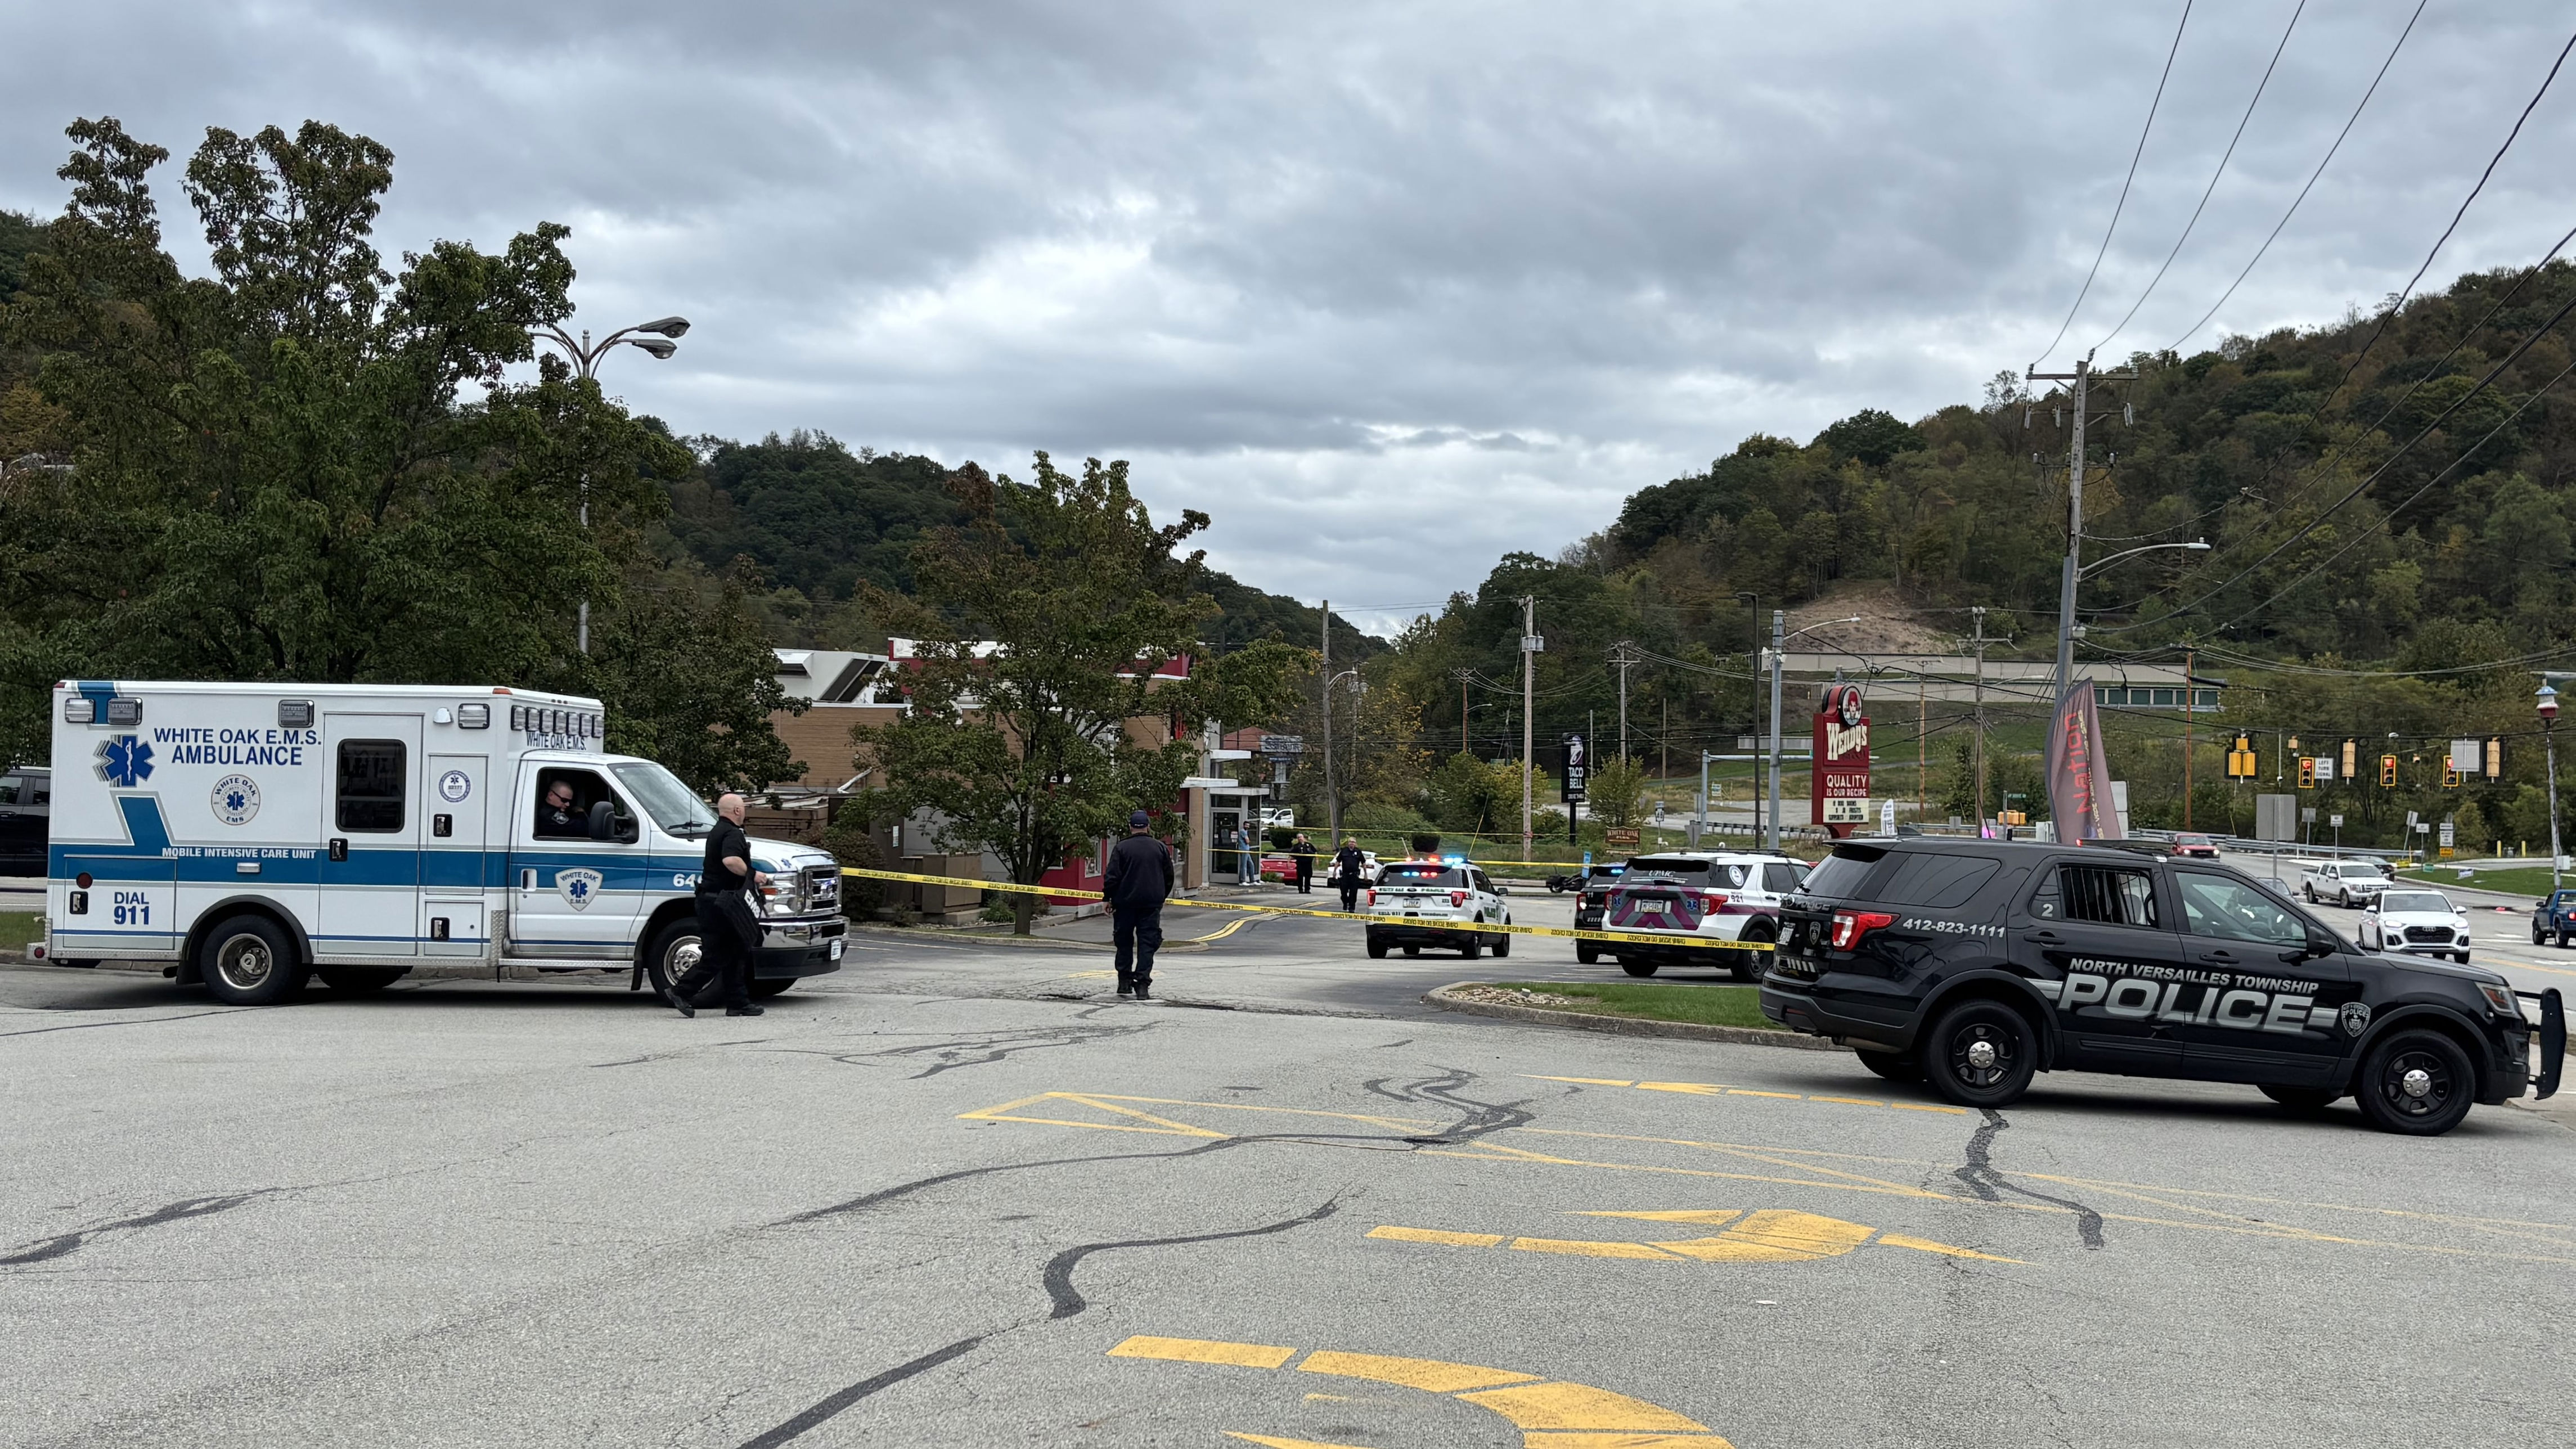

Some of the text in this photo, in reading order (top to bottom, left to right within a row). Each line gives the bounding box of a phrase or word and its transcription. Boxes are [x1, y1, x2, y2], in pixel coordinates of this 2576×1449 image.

[154, 727, 322, 745] WHITE OAK E.M.S.
[527, 731, 587, 751] WHITE OAK E.M.S.
[1826, 722, 1867, 760] Wendy's
[171, 745, 302, 766] AMBULANCE
[2064, 712, 2091, 814] Nation
[1568, 767, 1584, 777] TACO
[214, 777, 240, 795] WHITE
[242, 779, 257, 797] OAK
[1569, 778, 1584, 789] BELL
[1827, 775, 1867, 788] QUALITY
[1826, 788, 1867, 796] IS OUR RECIPE
[1627, 830, 1639, 838] OAK
[162, 847, 317, 860] MOBILE INTENSIVE CARE UNIT
[560, 871, 599, 882] WHITE OAK
[114, 892, 150, 905] DIAL
[1795, 901, 1831, 911] POLICE
[2041, 903, 2053, 917] 2
[114, 905, 150, 925] 911
[1903, 919, 2006, 938] 412-823-1111
[2069, 958, 2319, 994] NORTH VERSAILLES TOWNSHIP
[2057, 973, 2316, 1033] POLICE
[2345, 1009, 2367, 1018] POLICE
